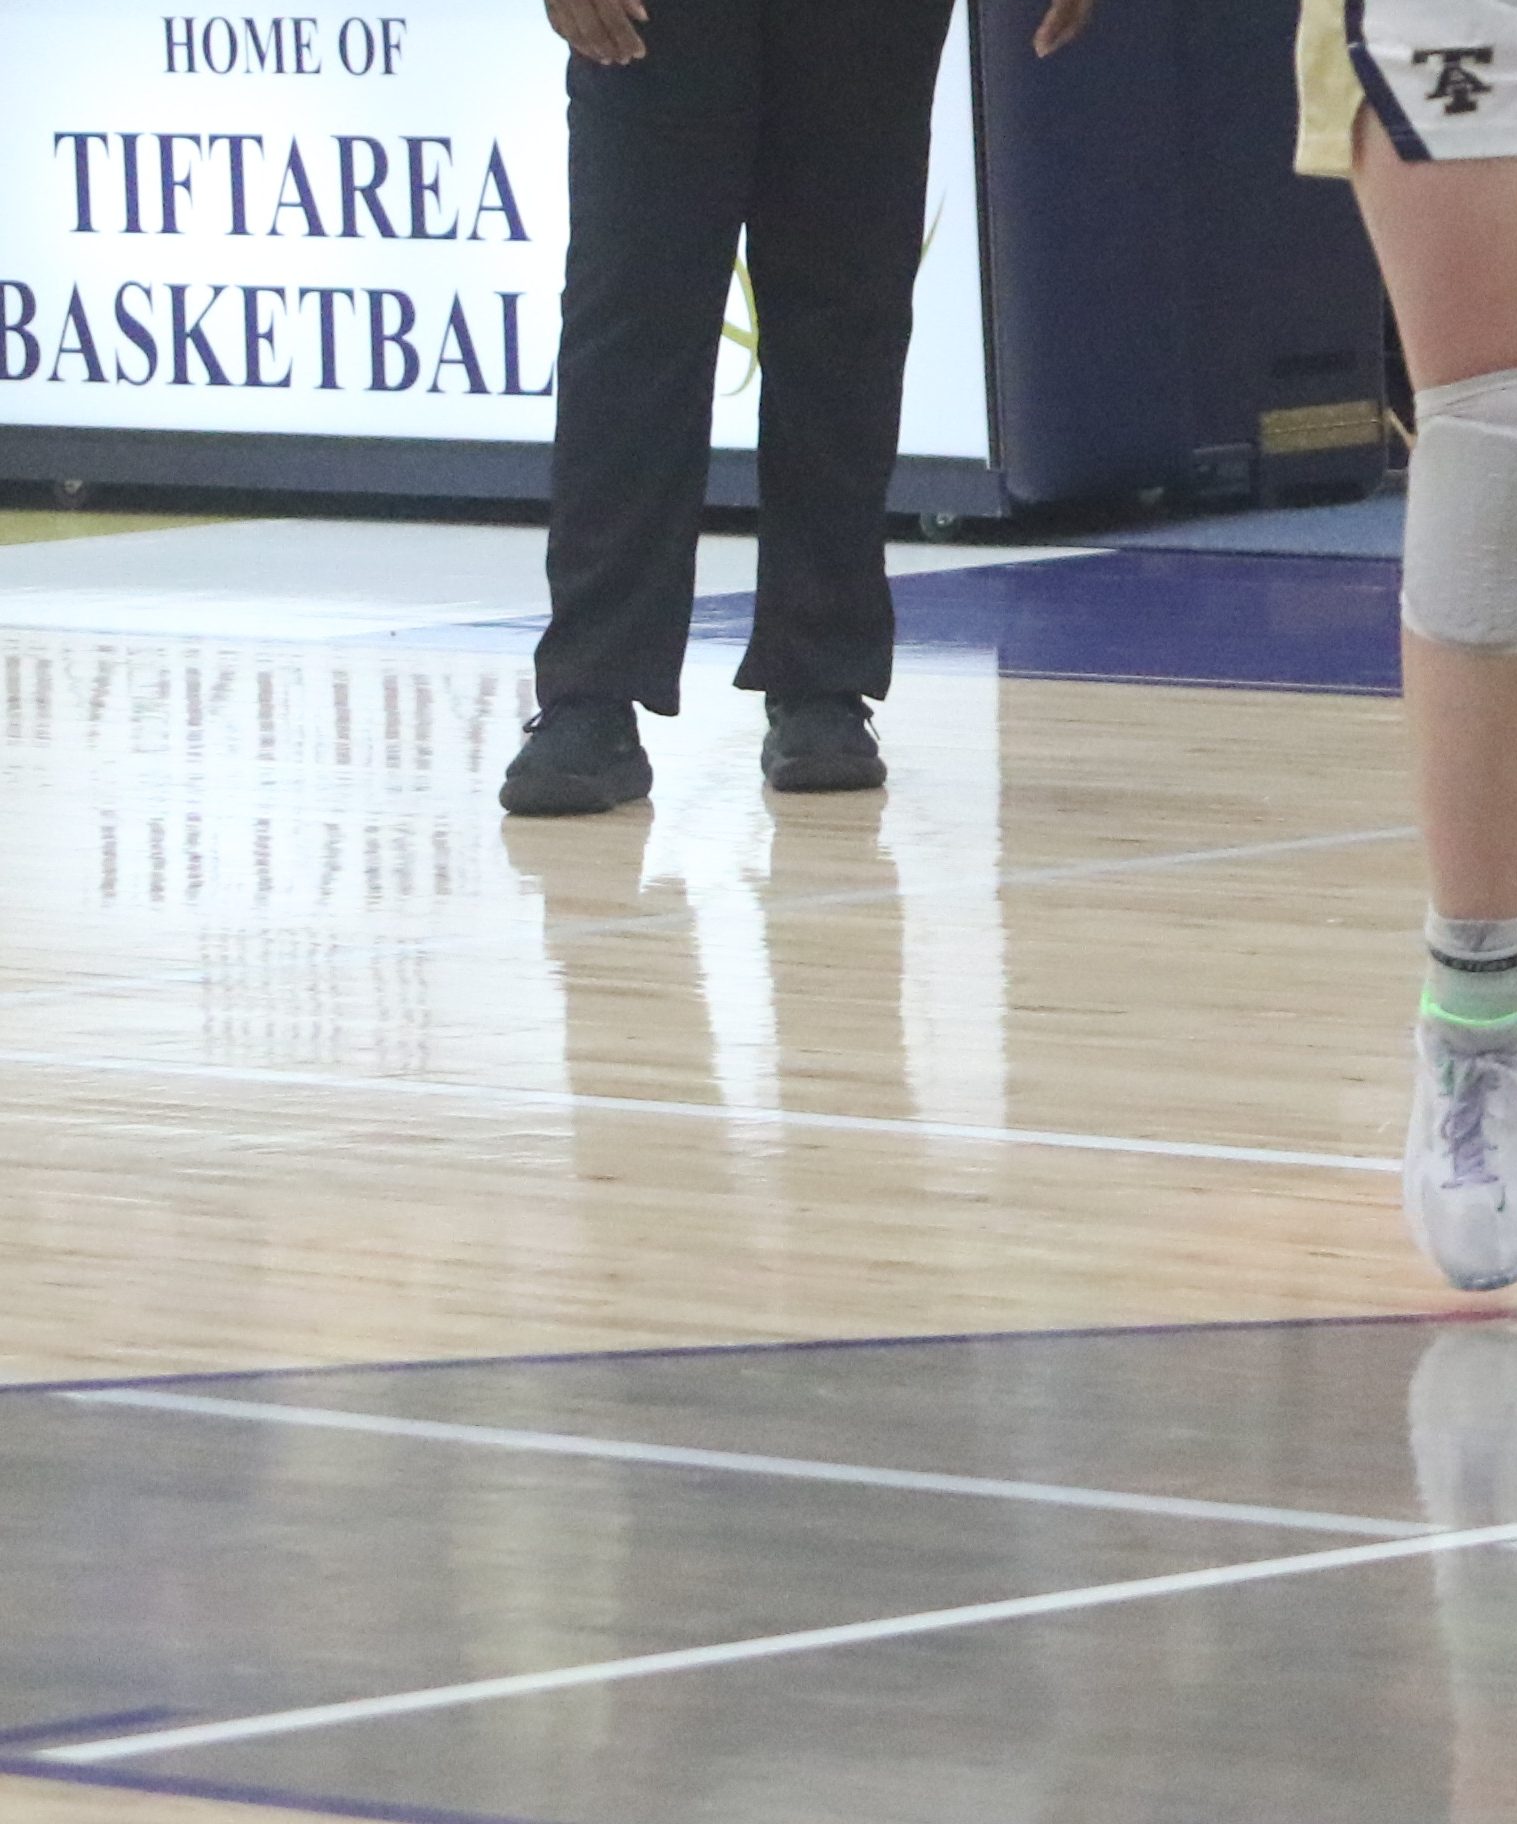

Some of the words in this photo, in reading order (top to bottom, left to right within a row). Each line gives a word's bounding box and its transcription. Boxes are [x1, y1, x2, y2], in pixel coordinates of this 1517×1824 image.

[164, 17, 320, 74] HOME
[339, 17, 406, 75] OF
[54, 132, 530, 241] TIFTAREA
[0, 280, 553, 396] BASKETBAL
